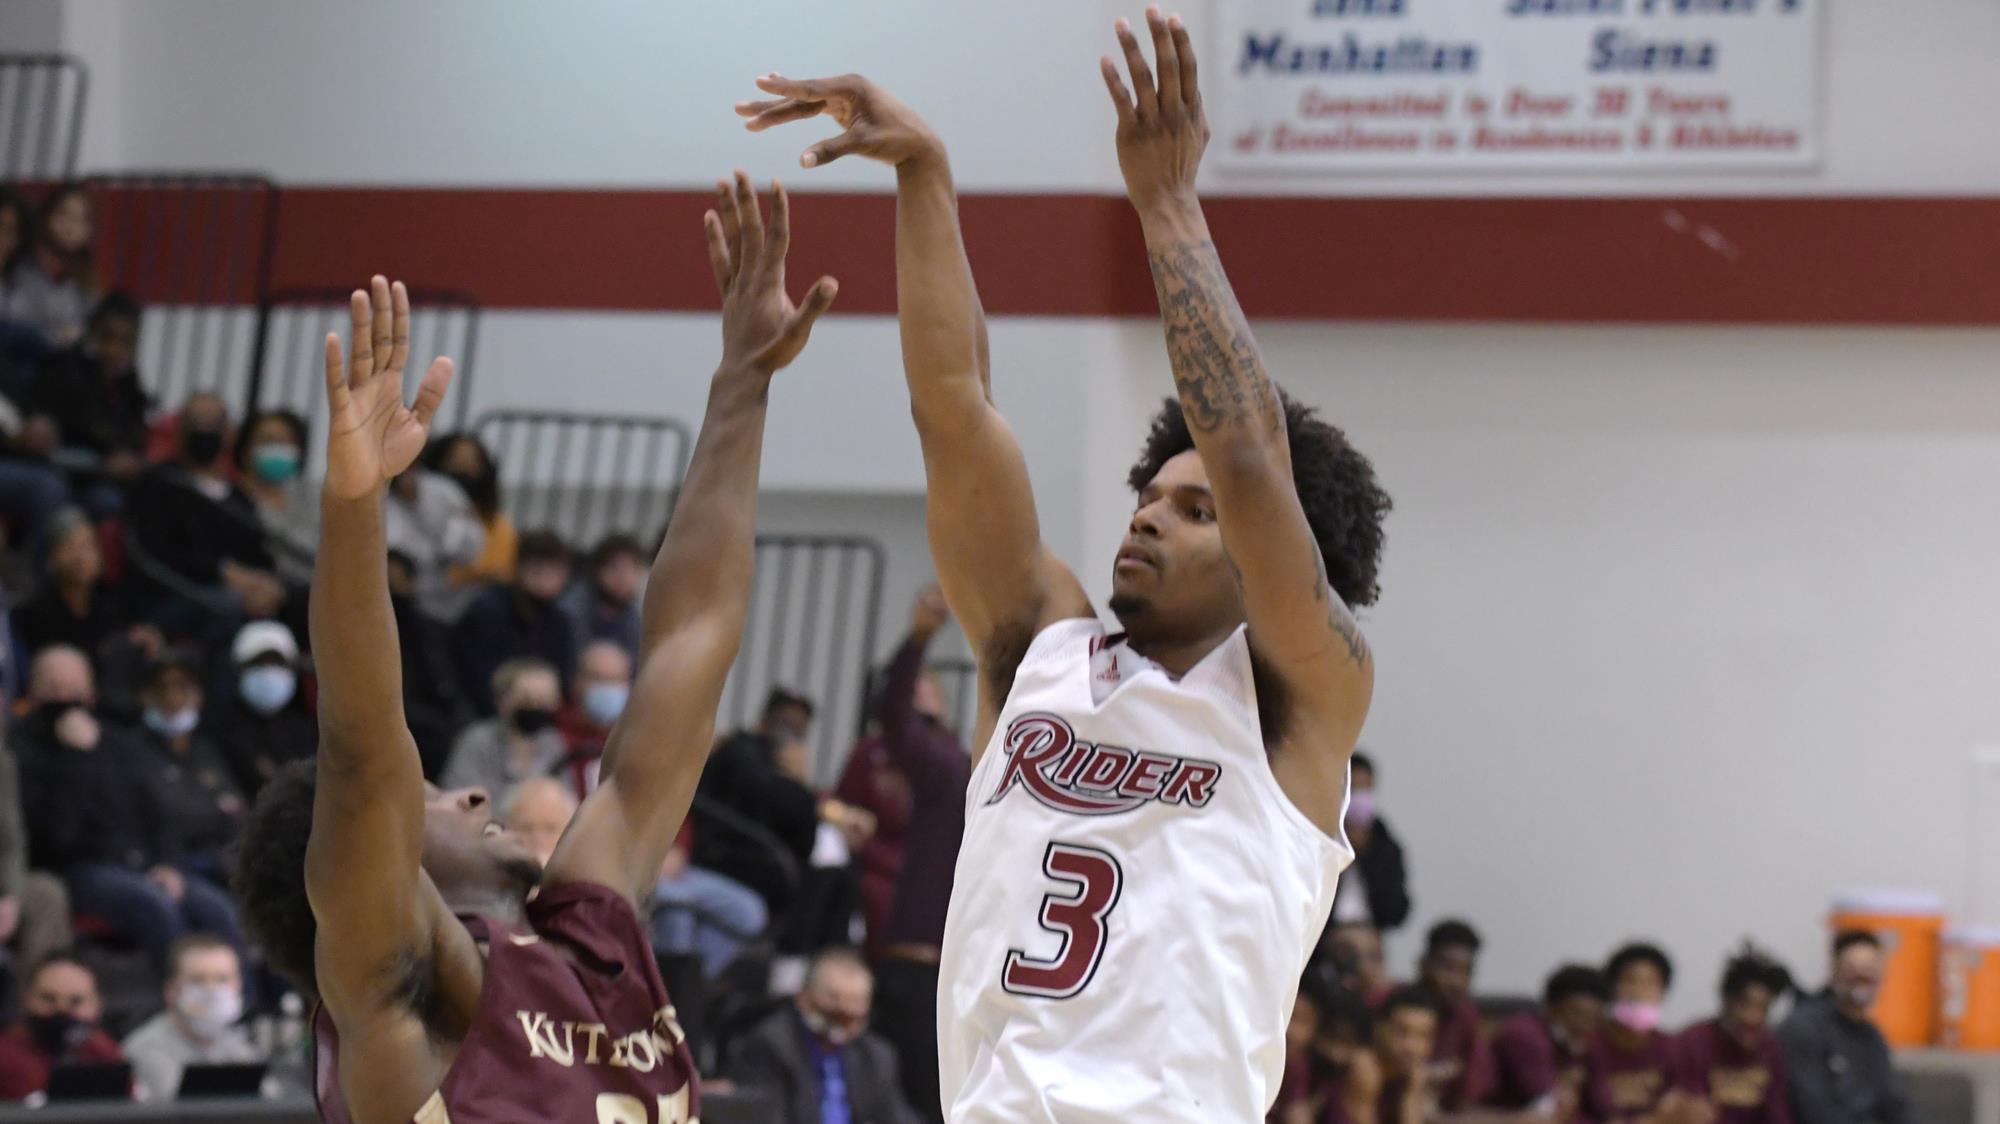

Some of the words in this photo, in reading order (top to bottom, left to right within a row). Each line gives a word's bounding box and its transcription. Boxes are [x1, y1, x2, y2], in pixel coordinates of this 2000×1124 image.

[1236, 32, 1479, 73] Manhattan
[1588, 29, 1718, 71] Siena
[1001, 841, 1123, 999] 3
